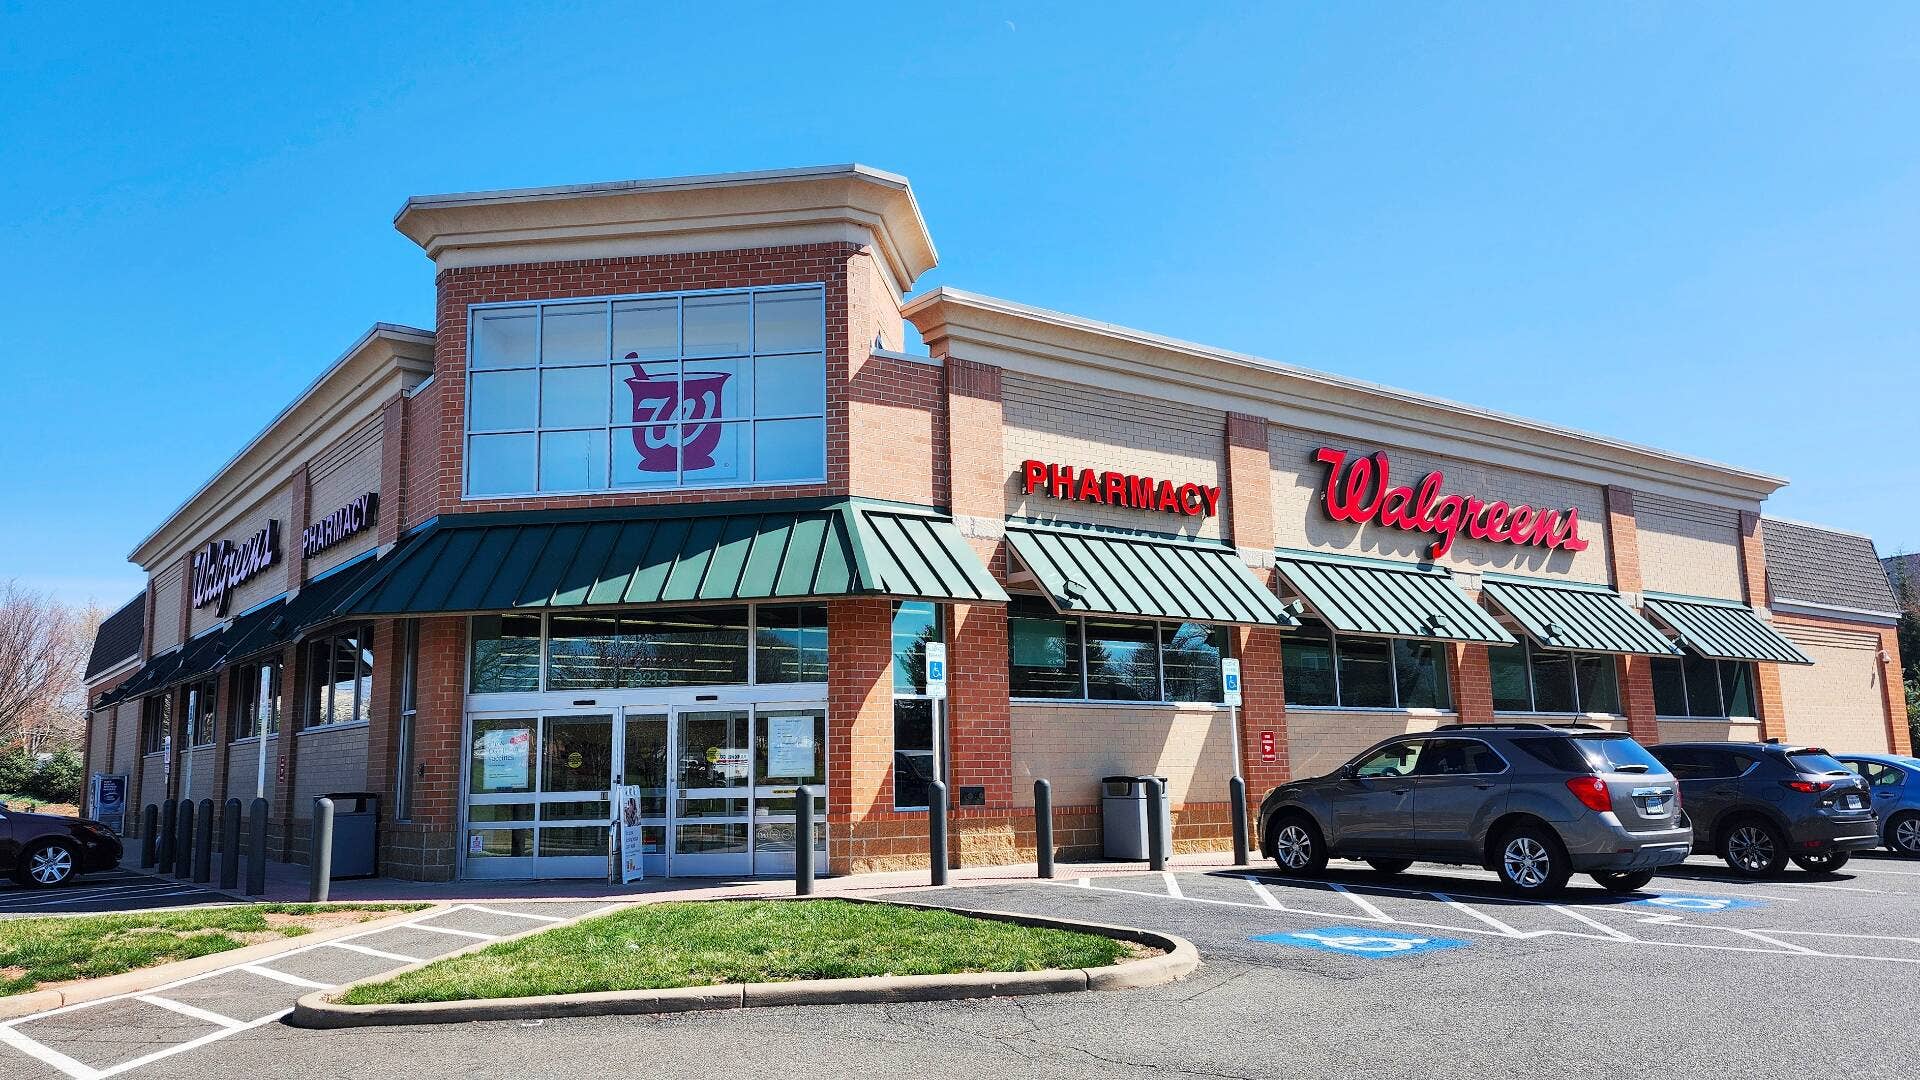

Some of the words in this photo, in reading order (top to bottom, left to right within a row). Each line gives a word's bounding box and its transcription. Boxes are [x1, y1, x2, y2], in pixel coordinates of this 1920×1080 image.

[302, 493, 376, 560] PHARMACY
[1022, 459, 1222, 517] PHARMACY
[1312, 447, 1588, 559] Walgreens
[193, 520, 278, 618] Walgreens
